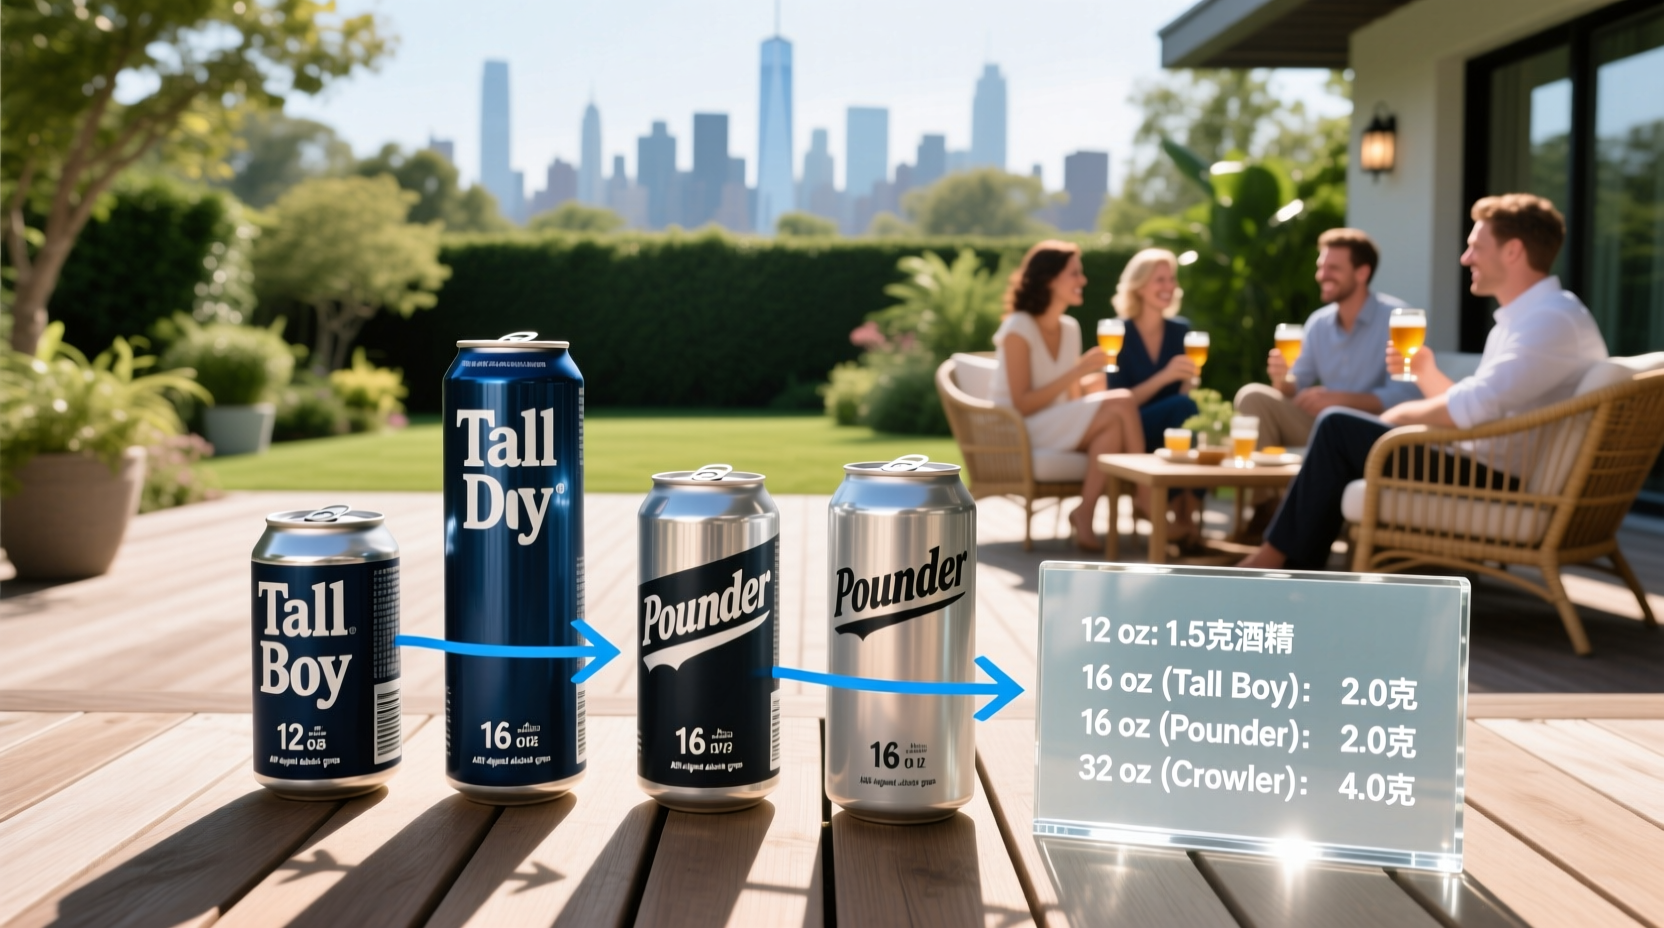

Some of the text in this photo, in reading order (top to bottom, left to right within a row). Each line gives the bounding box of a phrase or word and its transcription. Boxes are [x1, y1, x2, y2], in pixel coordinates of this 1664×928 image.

[456, 407, 558, 468] Tall
[833, 545, 968, 618] Pounder
[257, 579, 348, 638] Tall
[642, 568, 771, 647] Pounder
[1081, 616, 1295, 655] 12 oz: 1.5克酒精
[259, 639, 353, 710] Boy
[1082, 664, 1418, 711] 16 oz (Tall Boy): 2.0克
[277, 722, 304, 751] 12
[480, 721, 512, 750] 16
[675, 726, 706, 755] 16
[869, 741, 900, 770] 16
[1081, 708, 1417, 759] 16 oz (Pounder): 2.0克
[1078, 754, 1416, 807] 32 oz (Crowler): 4.0克
